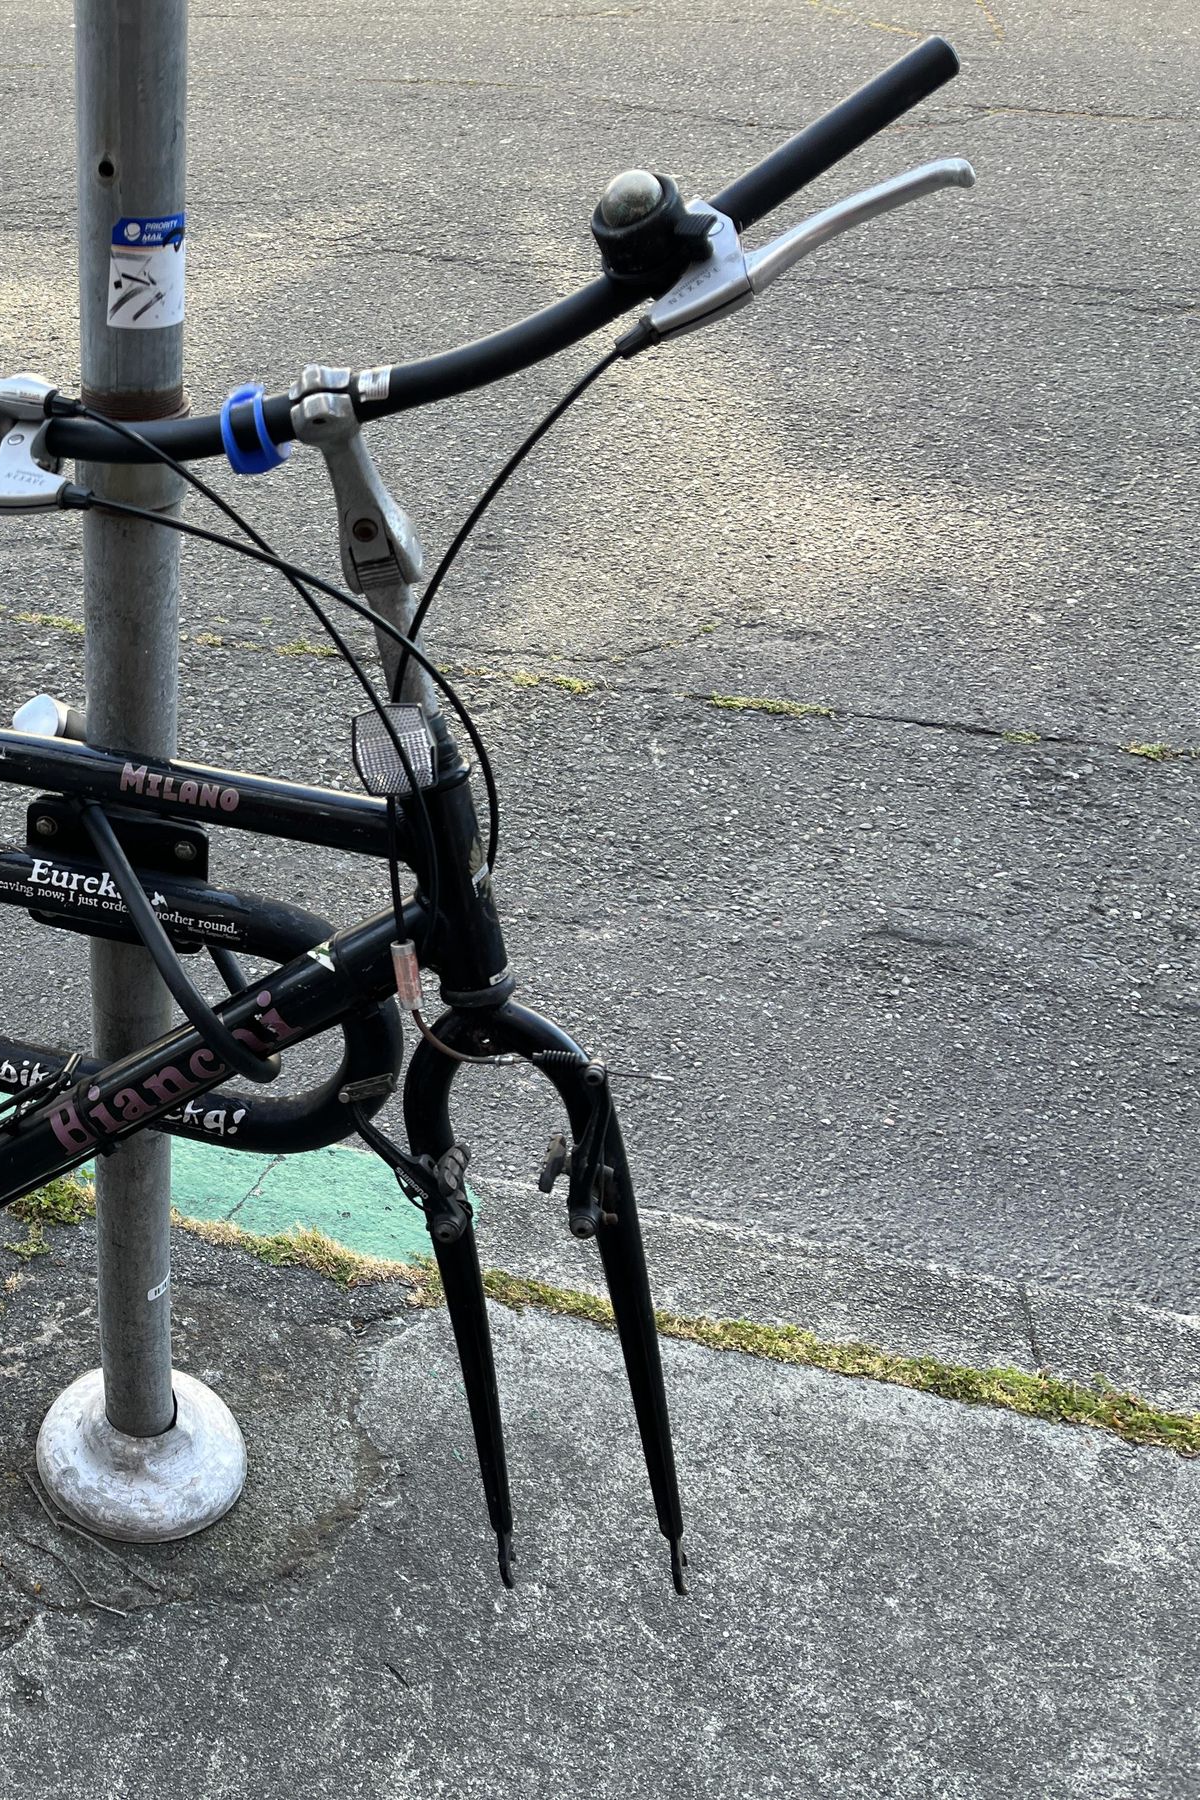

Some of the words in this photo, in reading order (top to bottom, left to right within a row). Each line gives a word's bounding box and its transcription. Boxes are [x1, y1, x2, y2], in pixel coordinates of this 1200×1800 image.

[142, 234, 163, 244] MAIL
[145, 220, 178, 231] PRIORITY
[120, 762, 240, 812] MILANO
[27, 858, 123, 899] Eurek
[37, 888, 65, 903] now;
[68, 891, 75, 903] I
[78, 893, 99, 908] just
[156, 911, 194, 927] nother
[198, 920, 238, 935] round.
